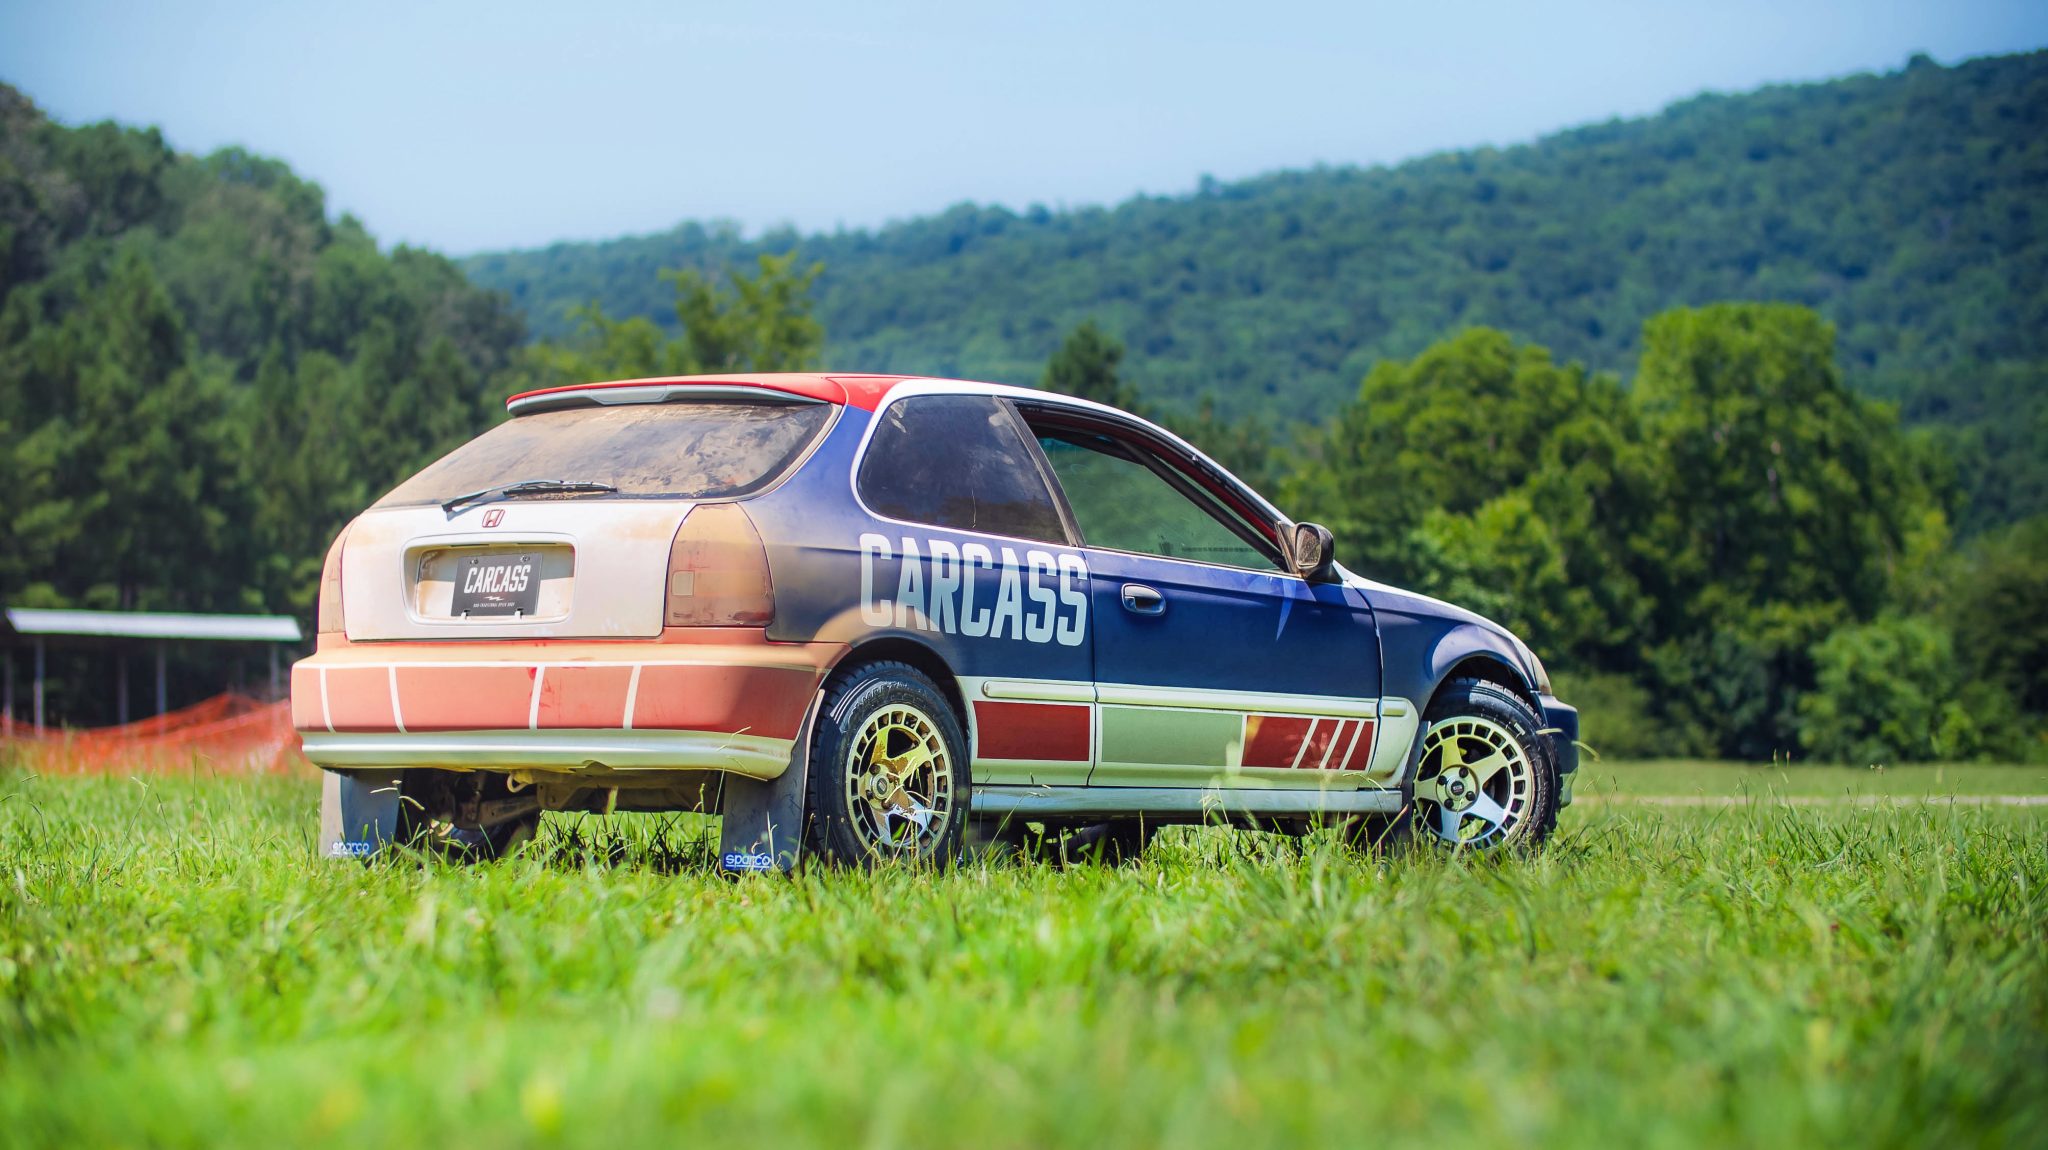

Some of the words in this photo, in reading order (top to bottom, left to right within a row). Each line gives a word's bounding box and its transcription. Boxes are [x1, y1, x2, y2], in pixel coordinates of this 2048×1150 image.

[463, 564, 531, 594] CARCASS
[859, 533, 1088, 647] CARCASS
[725, 854, 770, 868] sparco
